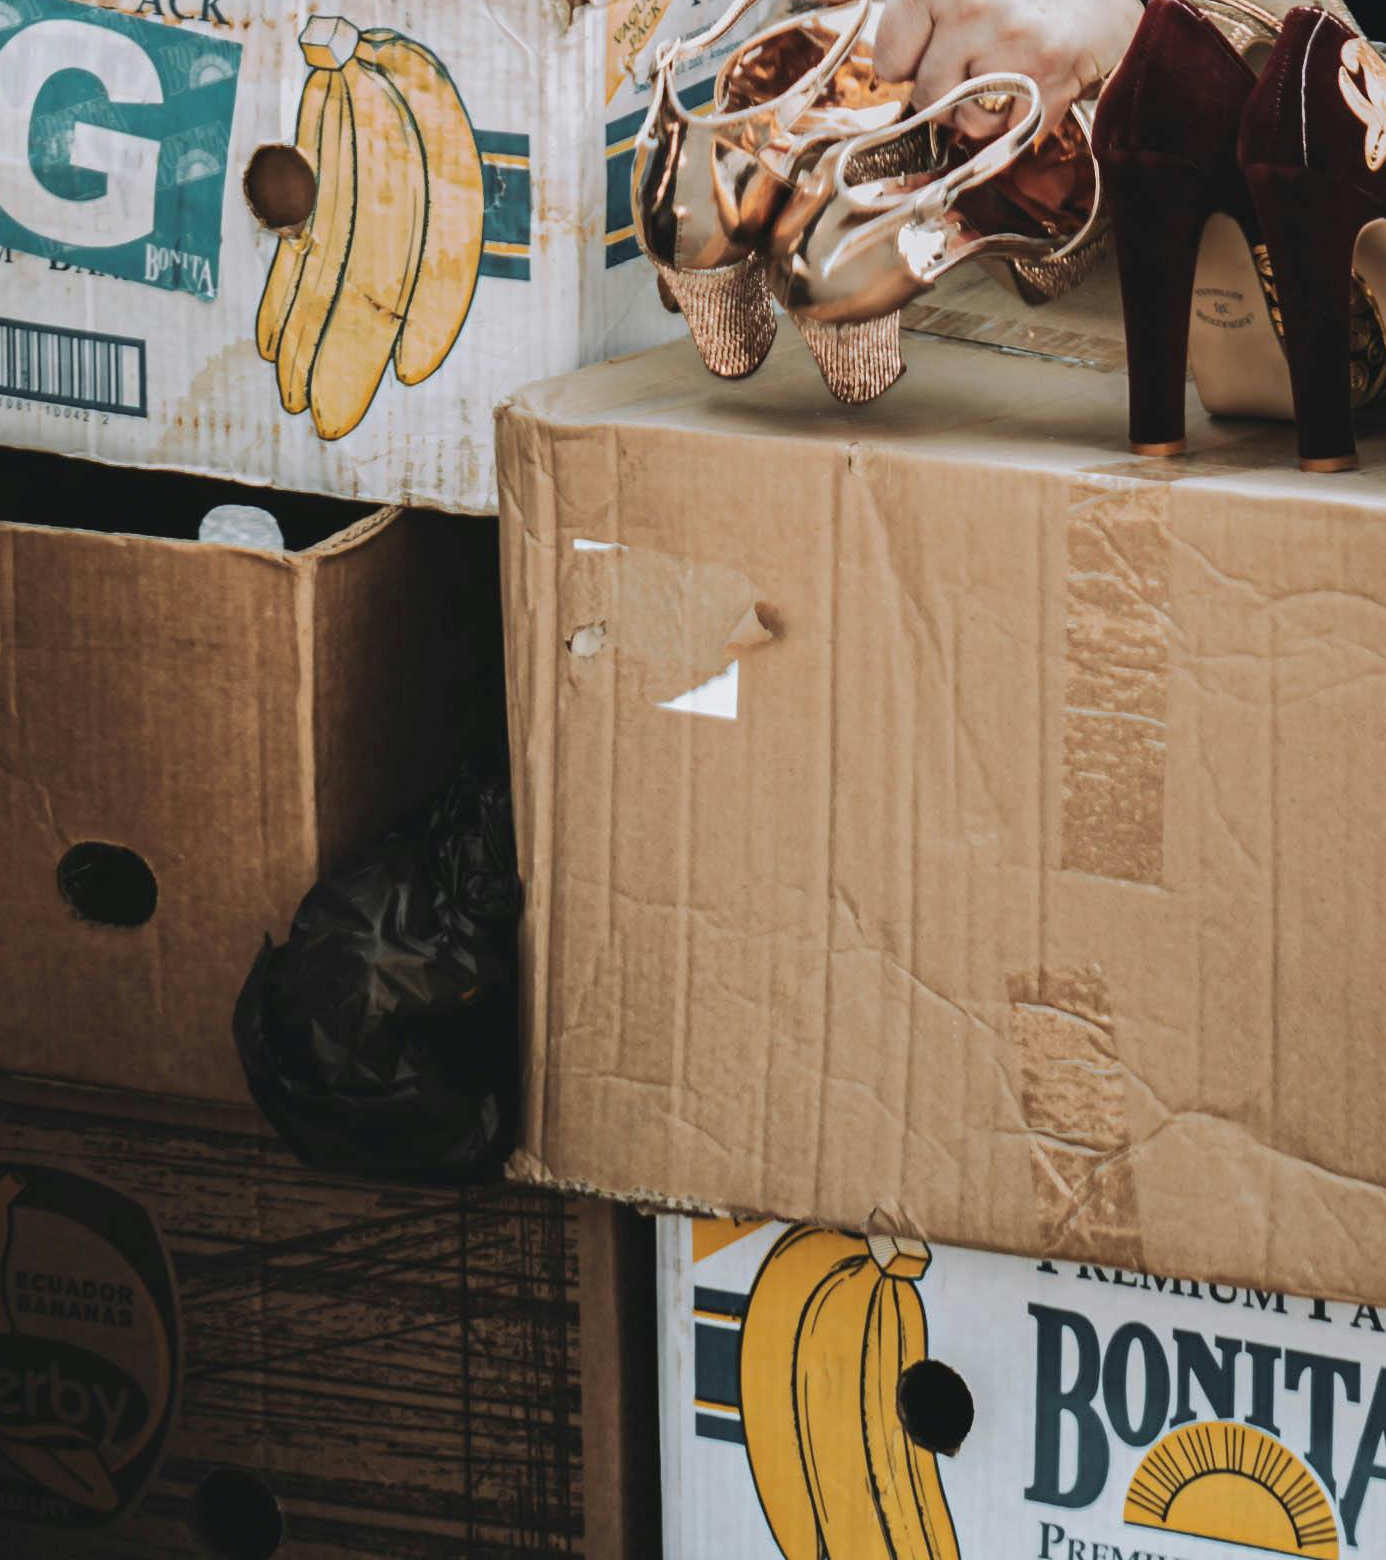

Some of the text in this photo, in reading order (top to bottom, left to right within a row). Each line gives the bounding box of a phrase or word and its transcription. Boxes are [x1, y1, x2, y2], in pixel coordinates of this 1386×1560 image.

[629, 2, 662, 51] PACK
[144, 242, 217, 298] BONITA
[45, 404, 90, 422] 10042
[102, 414, 110, 425] 2
[15, 1271, 134, 1302] ECUADOR
[1036, 1259, 1288, 1314] EMIUM
[15, 1298, 134, 1329] BANANAS
